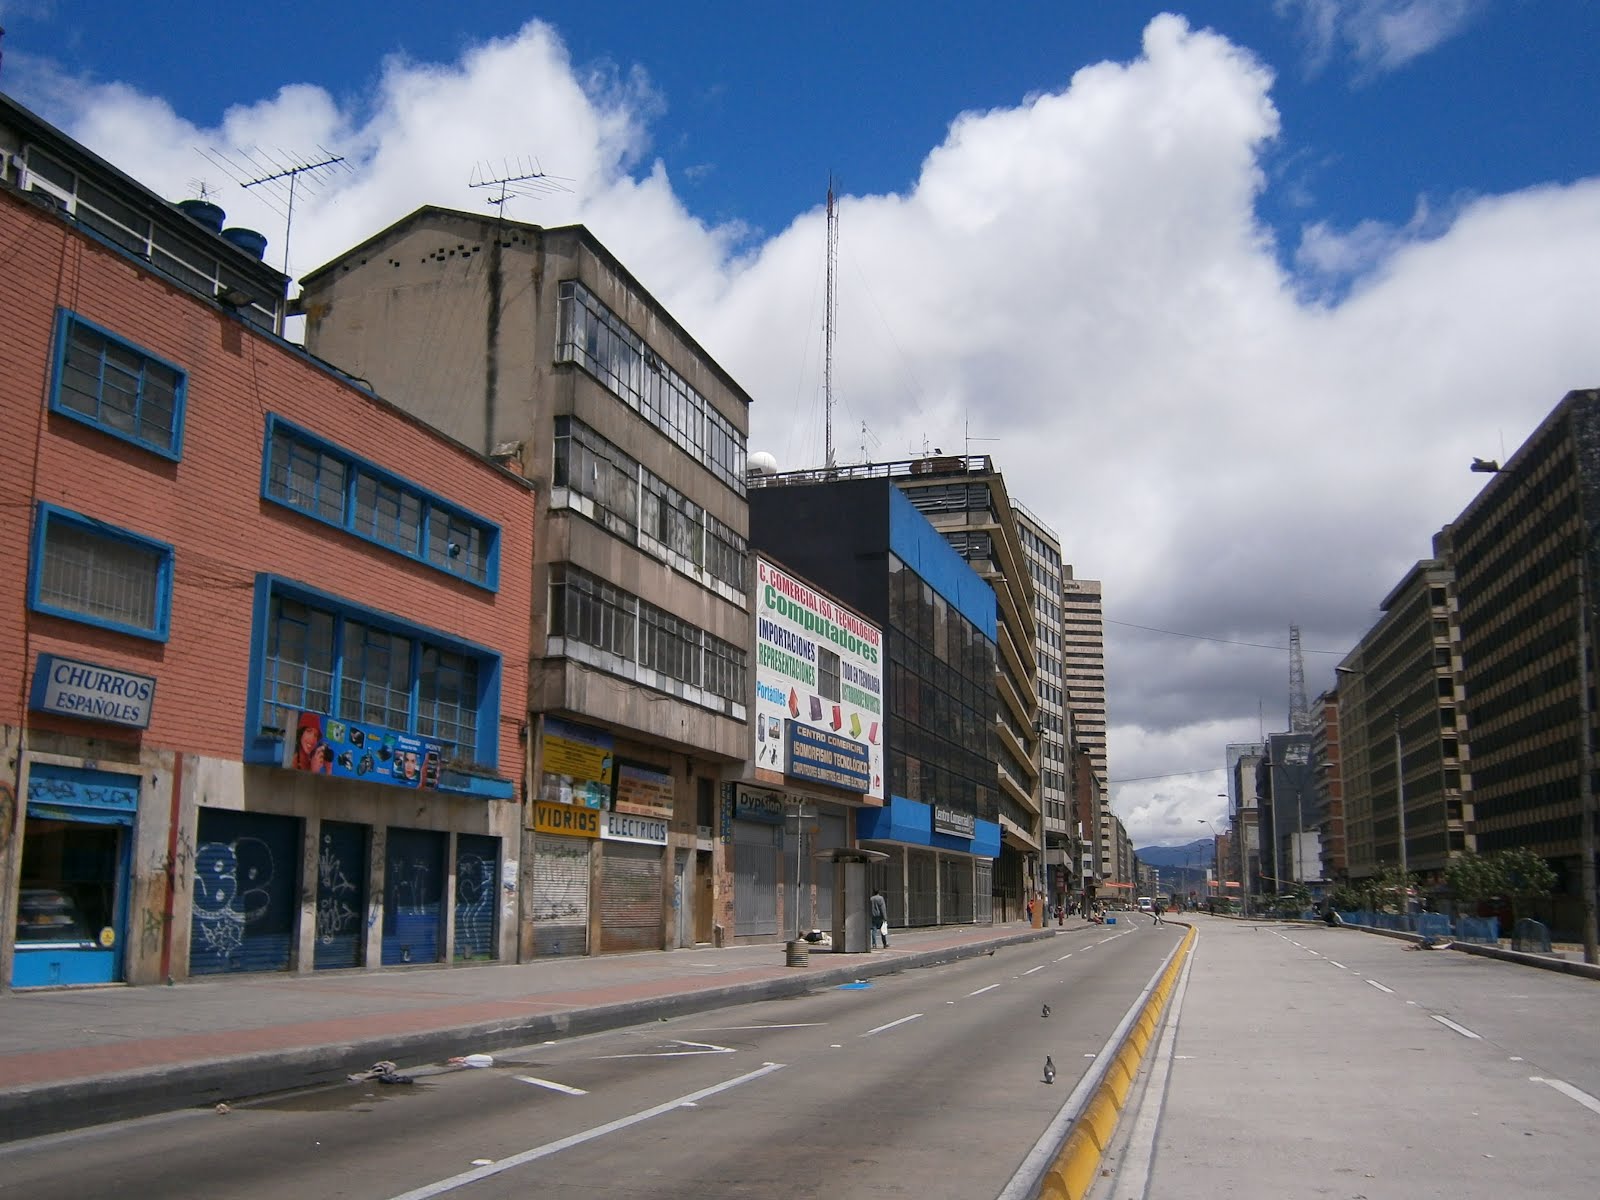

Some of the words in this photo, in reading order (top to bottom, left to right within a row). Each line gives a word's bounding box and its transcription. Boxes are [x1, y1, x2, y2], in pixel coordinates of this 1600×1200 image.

[770, 570, 818, 612] COMERCIAL
[759, 616, 816, 663] IMPORTACIONES
[764, 584, 878, 665] Computadores
[54, 664, 150, 701] CHURROS
[759, 642, 816, 687] REPRESENTACIONES
[56, 692, 140, 722] ESPAÑOLES
[796, 725, 826, 742] CENTRO
[827, 736, 865, 755] COMERCIAL
[537, 807, 597, 832] VIDRIOS
[608, 816, 666, 841] ELECTRICOS
